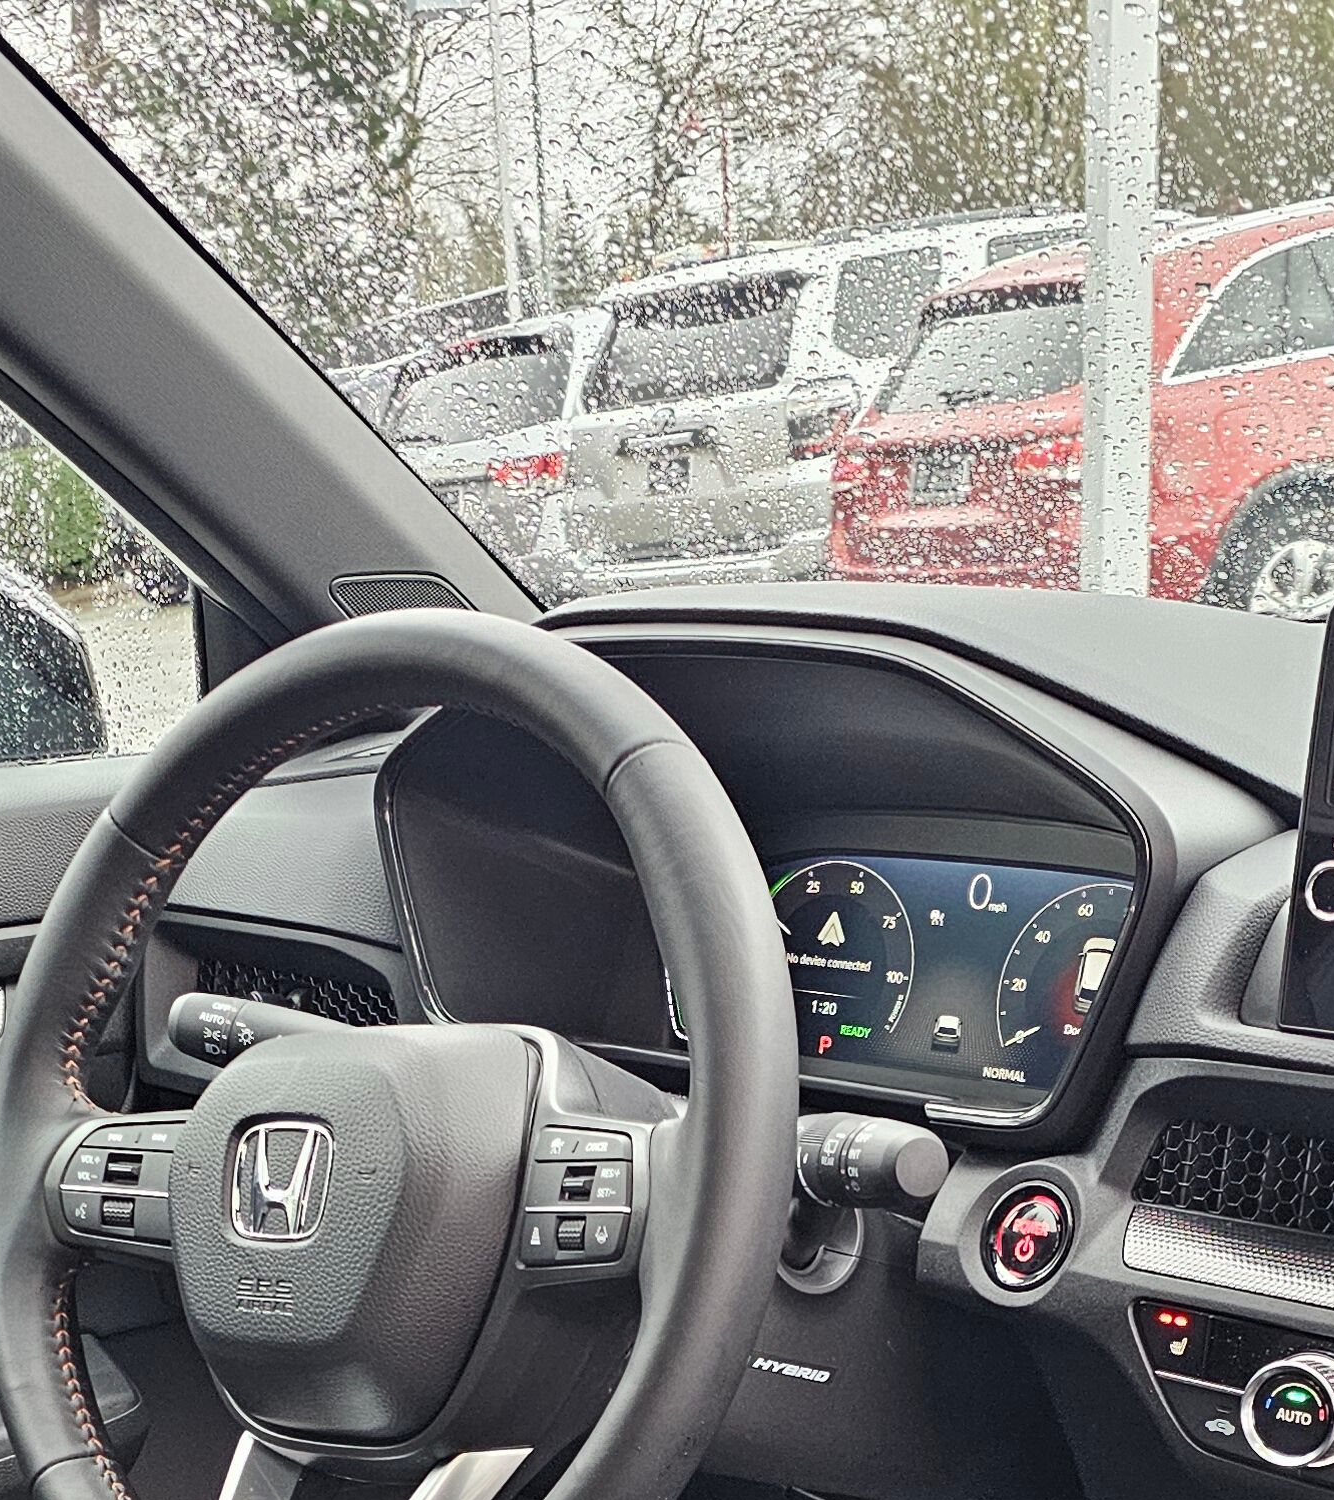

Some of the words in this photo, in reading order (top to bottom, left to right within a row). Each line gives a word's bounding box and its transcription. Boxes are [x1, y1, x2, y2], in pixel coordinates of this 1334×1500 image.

[805, 880, 821, 894] 25
[849, 880, 865, 895] 50
[968, 873, 993, 910] 0
[988, 902, 1008, 914] mph
[1077, 903, 1094, 917] 60
[882, 915, 897, 930] 75
[1034, 930, 1052, 944] 40
[799, 953, 827, 968] device
[827, 958, 872, 973] connected
[885, 970, 904, 985] 100
[1009, 978, 1028, 992] 20
[810, 999, 838, 1016] 1:20
[198, 1011, 225, 1026] AUTO
[839, 1024, 872, 1039] READY
[818, 1035, 833, 1055] P
[983, 1065, 1027, 1083] NORMAL
[752, 1357, 831, 1383] HYBRID
[1275, 1407, 1313, 1427] AUTO
